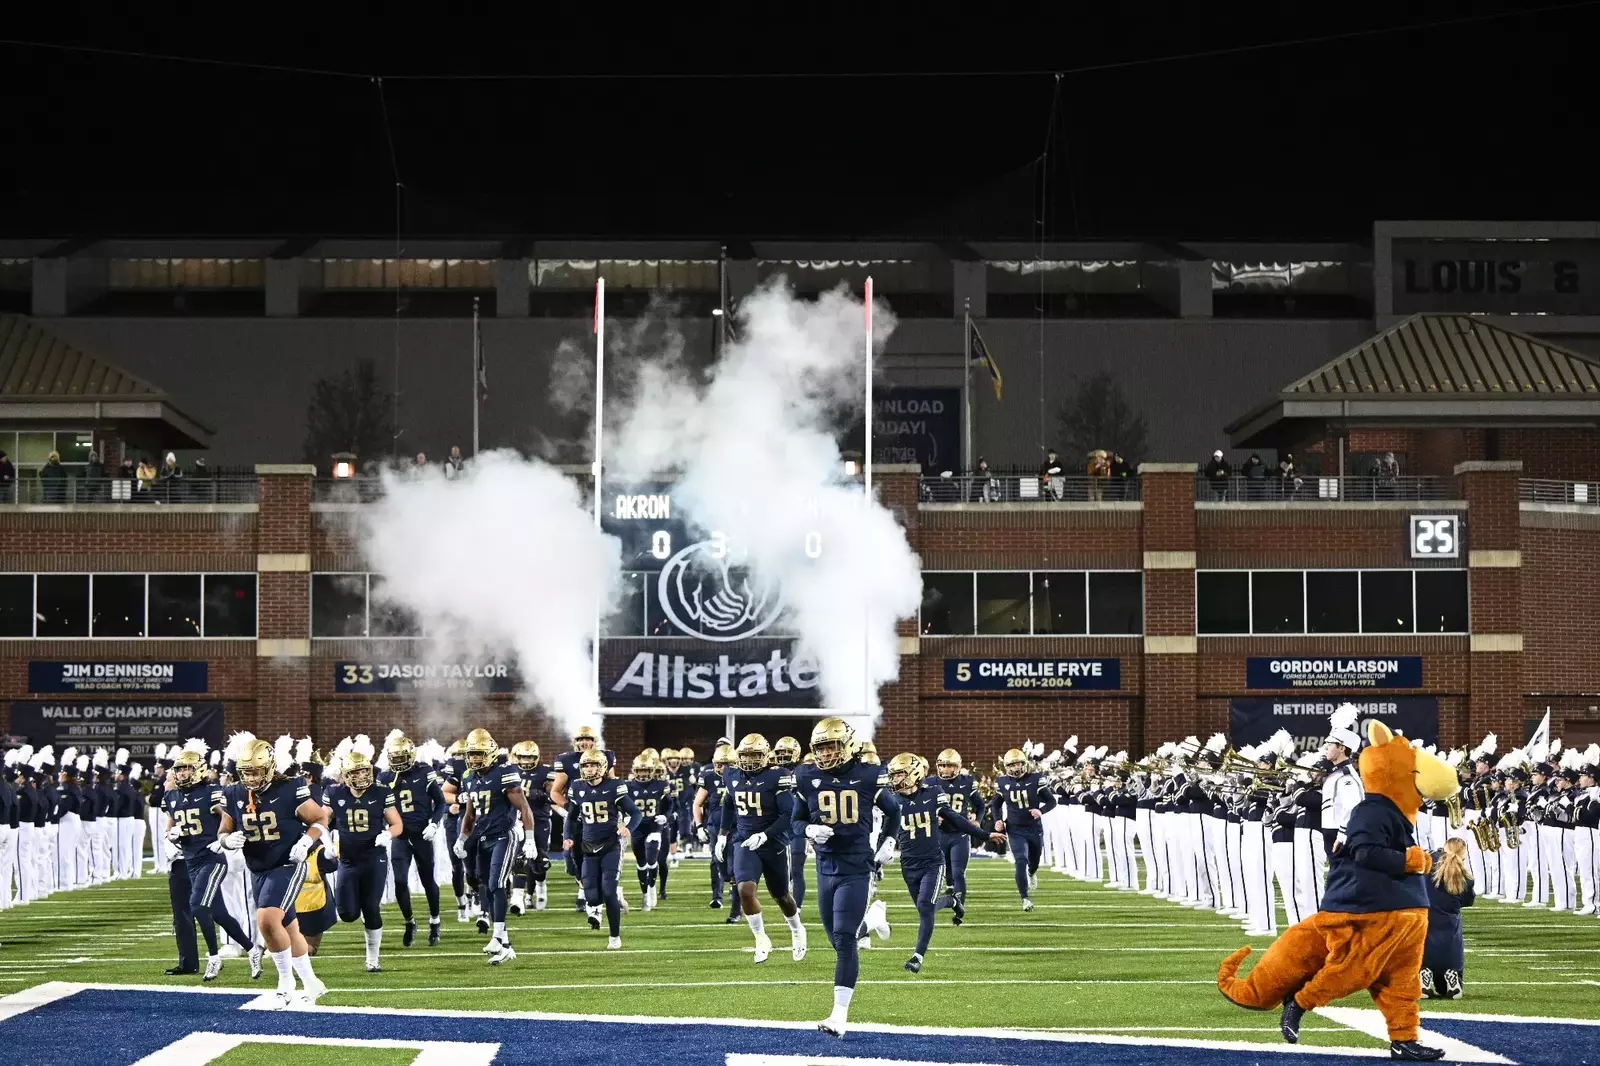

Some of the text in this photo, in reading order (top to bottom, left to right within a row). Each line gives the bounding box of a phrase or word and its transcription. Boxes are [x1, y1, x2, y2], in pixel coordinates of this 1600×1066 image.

[1405, 260, 1580, 293] LOUIS &
[872, 400, 944, 414] WNLOAD
[615, 495, 670, 519] AKRON
[652, 531, 671, 560] 0
[805, 531, 822, 558] 0
[1416, 520, 1453, 553] 25
[63, 664, 174, 677] JIM DENNISON
[343, 664, 508, 684] 33 JASON TAYLOR
[611, 649, 821, 699] Allstate
[956, 662, 1102, 682] 5 CHARLIE FRYE
[1270, 660, 1398, 673] GORDON LARSON
[1007, 678, 1072, 688] 2001-2004
[42, 706, 193, 718] WALL OF CHAMPIONS
[1273, 703, 1335, 715] RETIRED
[90, 726, 115, 734] TEAM
[130, 726, 178, 735] 2005 TEAM
[131, 745, 149, 754] 2017
[400, 789, 414, 813] 2
[735, 791, 763, 816] 54
[817, 790, 859, 825] 90
[1009, 790, 1030, 809] 41
[174, 808, 203, 836] 25
[345, 808, 369, 832] 19
[581, 801, 609, 824] 95
[242, 811, 280, 842] 52
[900, 811, 931, 839] 44
